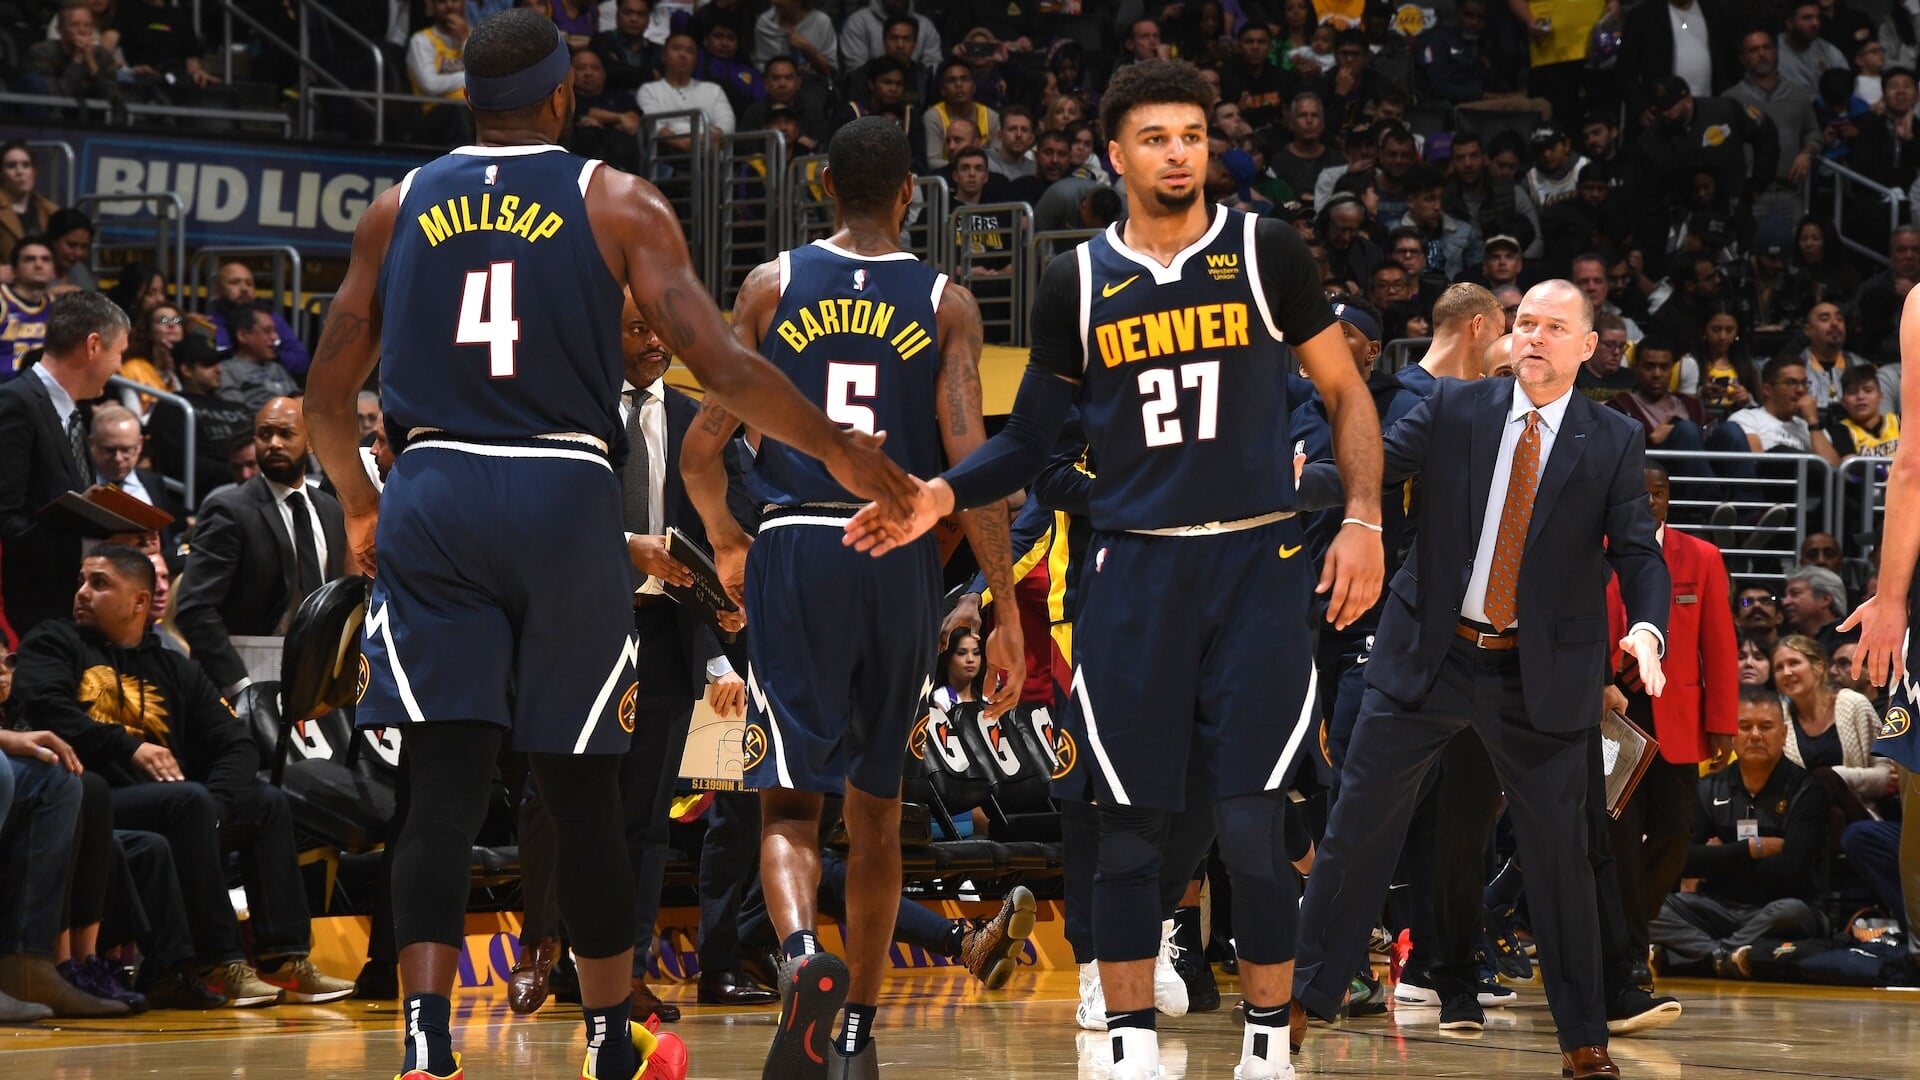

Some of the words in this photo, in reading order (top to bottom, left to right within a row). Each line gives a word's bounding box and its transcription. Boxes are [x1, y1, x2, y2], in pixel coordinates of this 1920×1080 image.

[96, 156, 248, 223] BUD
[258, 169, 392, 233] LIG
[417, 193, 564, 247] MILLSAP
[1206, 253, 1238, 267] WU
[454, 259, 521, 379] 4
[776, 298, 896, 353] BARTON
[890, 320, 932, 361] III
[1095, 302, 1250, 368] DENVER
[825, 360, 879, 437] 5
[1137, 360, 1220, 448] 27
